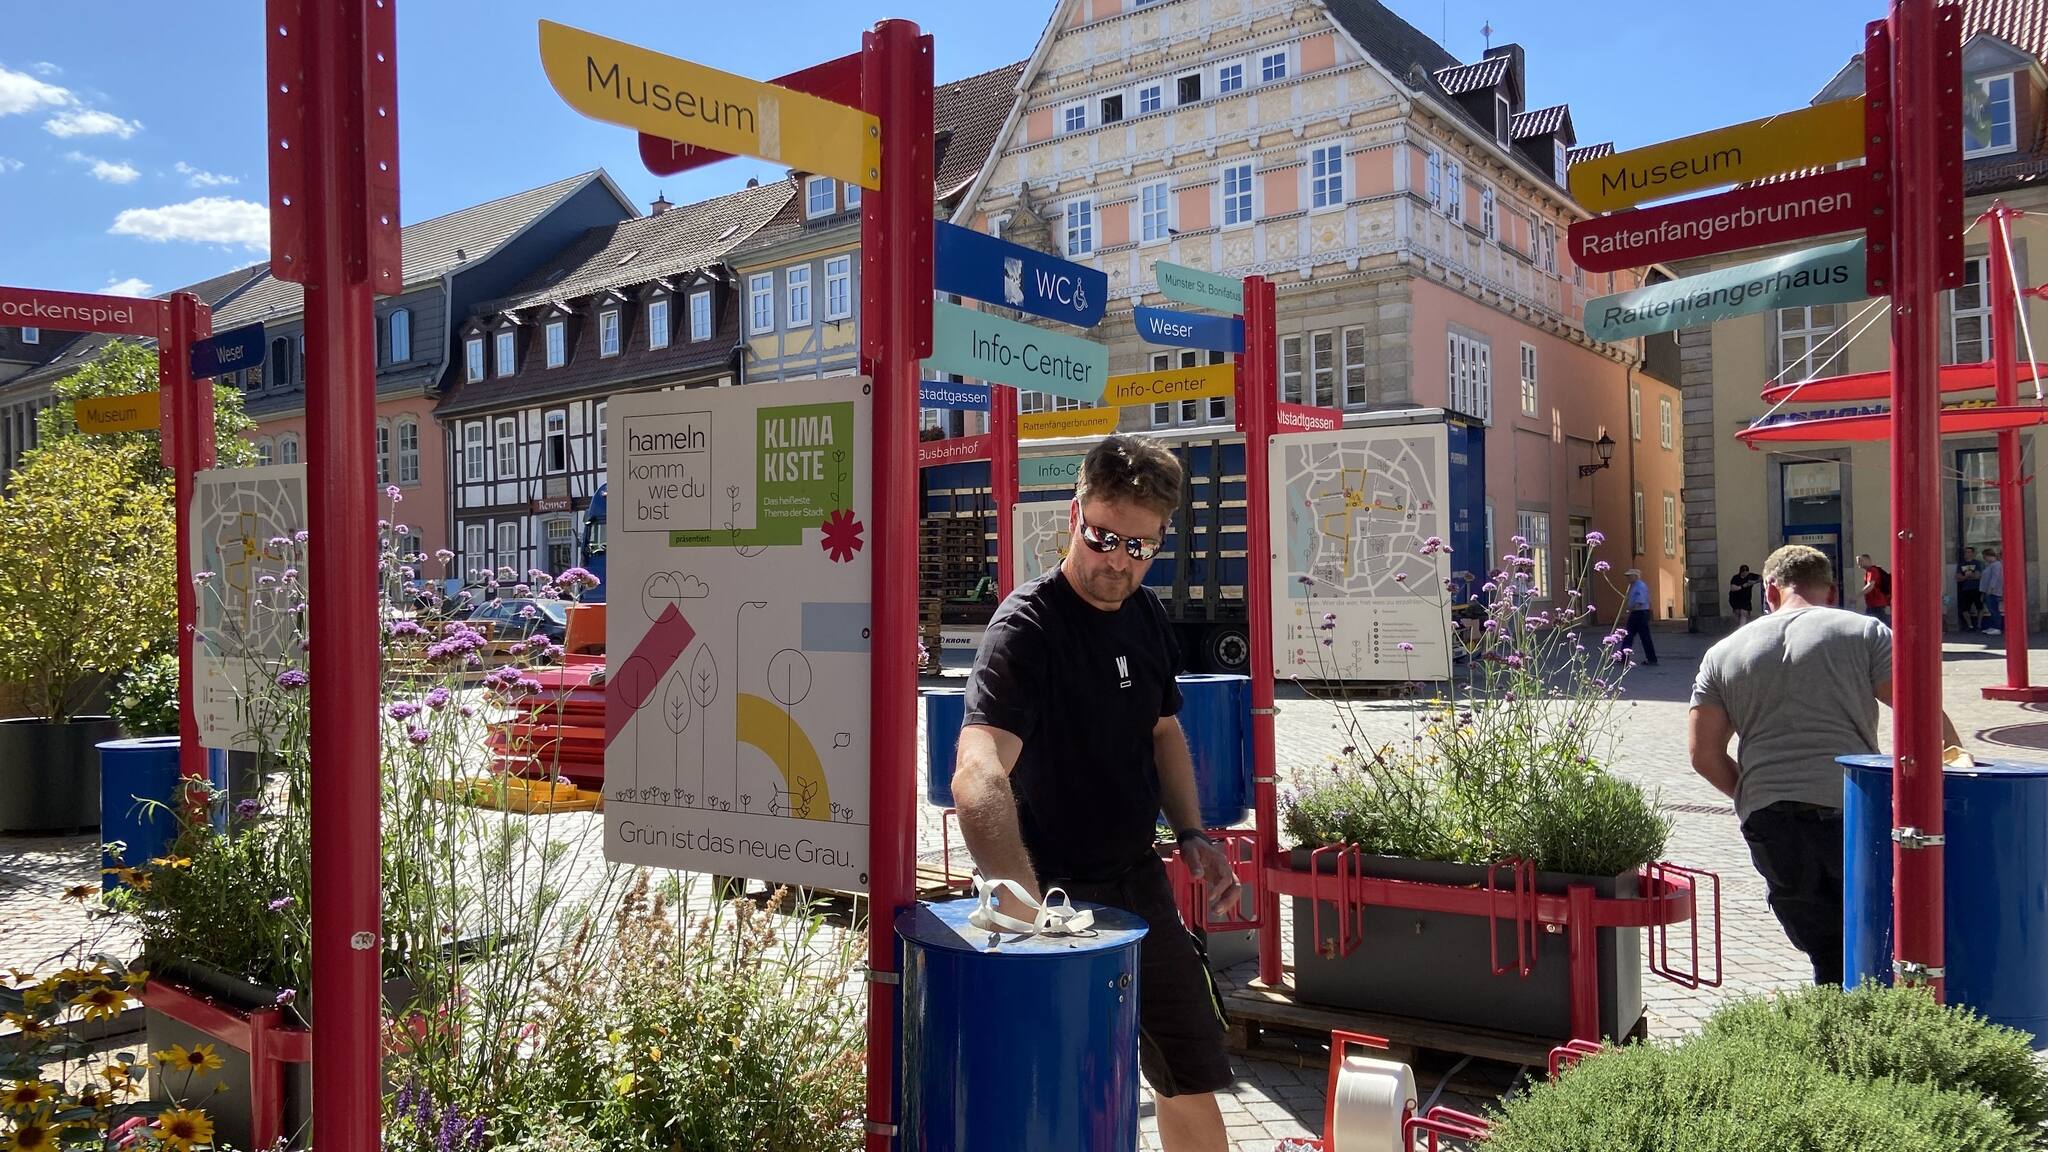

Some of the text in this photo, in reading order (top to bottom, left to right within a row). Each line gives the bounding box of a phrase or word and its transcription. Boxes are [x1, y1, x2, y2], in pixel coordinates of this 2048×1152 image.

[587, 56, 755, 134] Museum
[1601, 144, 1743, 197] Museum
[1582, 191, 1853, 257] Rattenfangerbrunnen
[1036, 269, 1071, 304] WC
[1165, 274, 1195, 290] Münster
[1208, 286, 1241, 301] Bonifatius
[1602, 263, 1850, 329] Rattenfängerhaus
[1150, 317, 1193, 338] Weser
[216, 344, 244, 364] Weser
[972, 329, 1092, 384] Info-Center
[920, 387, 988, 405] stadtgassen
[1116, 375, 1207, 399] Info-Center
[87, 407, 137, 424] Museum
[629, 424, 705, 451] hameln
[764, 415, 834, 449] KLIMA
[919, 441, 979, 461] Busbahnhof
[629, 460, 685, 481] komm
[764, 451, 825, 482] KISTE
[1038, 463, 1080, 477] Info-Ce
[648, 477, 705, 499] wie du
[539, 500, 568, 510] Renner
[637, 499, 670, 521] bist
[764, 495, 810, 505] Das heißeste
[764, 507, 824, 518] Thema der Stadt
[675, 533, 712, 544] präsentiert:
[619, 820, 855, 869] Grün ist das neue Grau.
